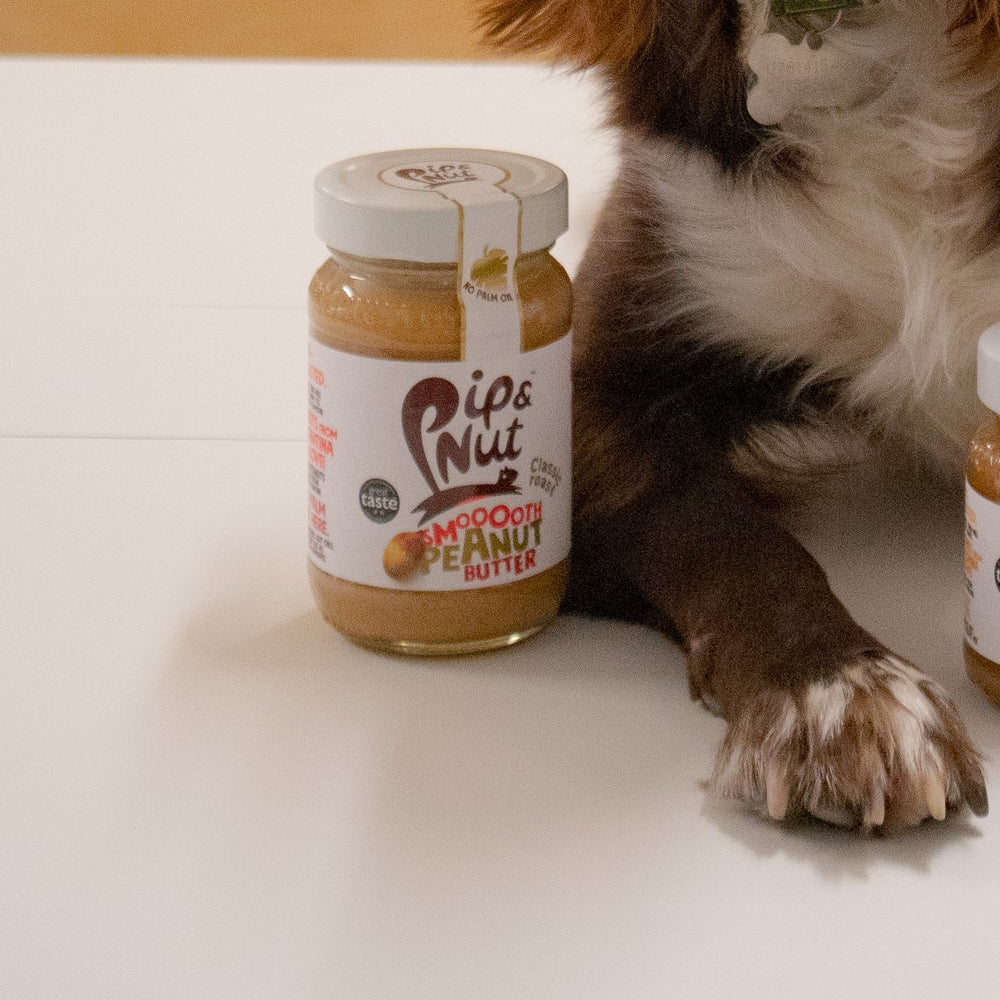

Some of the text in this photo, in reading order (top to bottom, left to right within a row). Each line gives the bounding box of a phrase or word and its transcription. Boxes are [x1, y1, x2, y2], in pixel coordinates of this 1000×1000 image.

[463, 281, 513, 302] NO PALM OIL
[436, 418, 524, 484] Nut
[361, 493, 398, 510] taste
[419, 518, 543, 574] PEANUT
[464, 549, 536, 581] BUTTER
